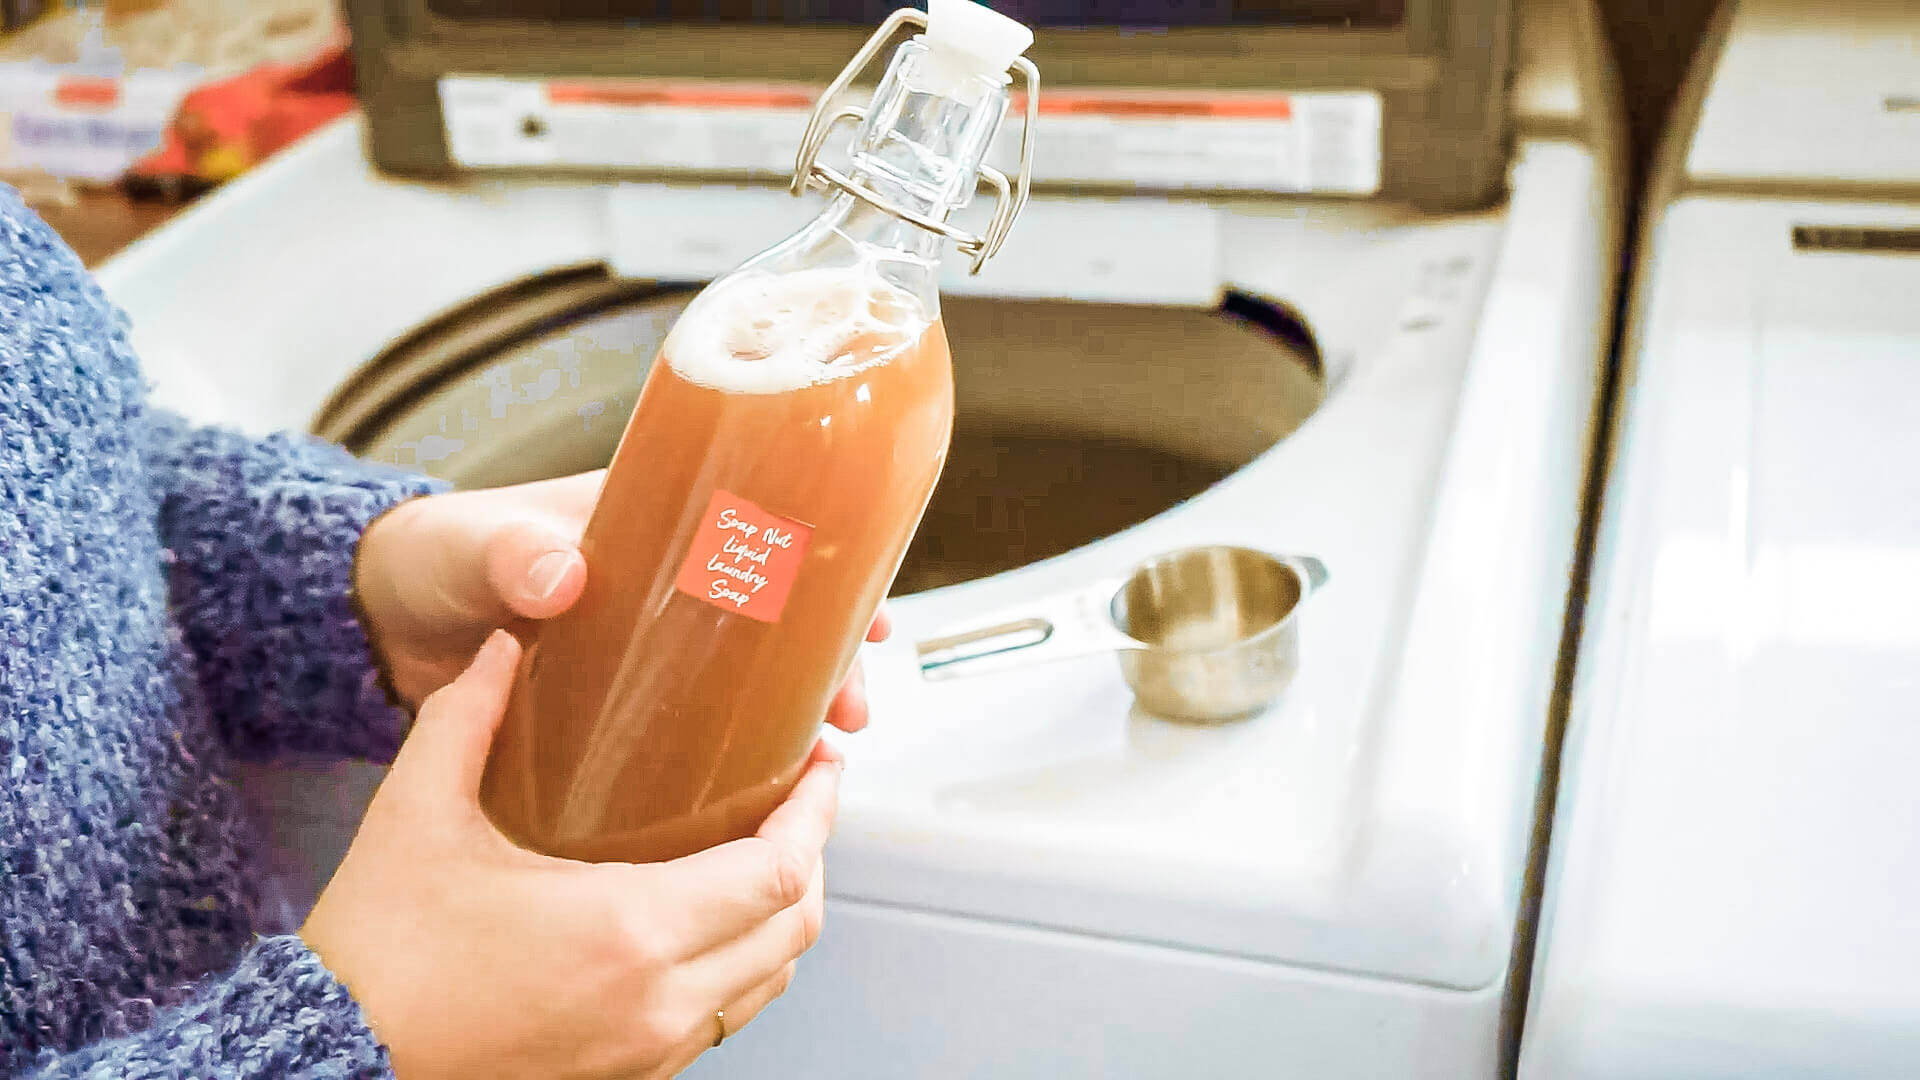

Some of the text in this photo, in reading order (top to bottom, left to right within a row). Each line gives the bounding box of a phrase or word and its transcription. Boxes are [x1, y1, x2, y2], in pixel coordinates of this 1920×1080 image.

[717, 509, 792, 548] Soap Nut
[708, 579, 749, 607] Soap
